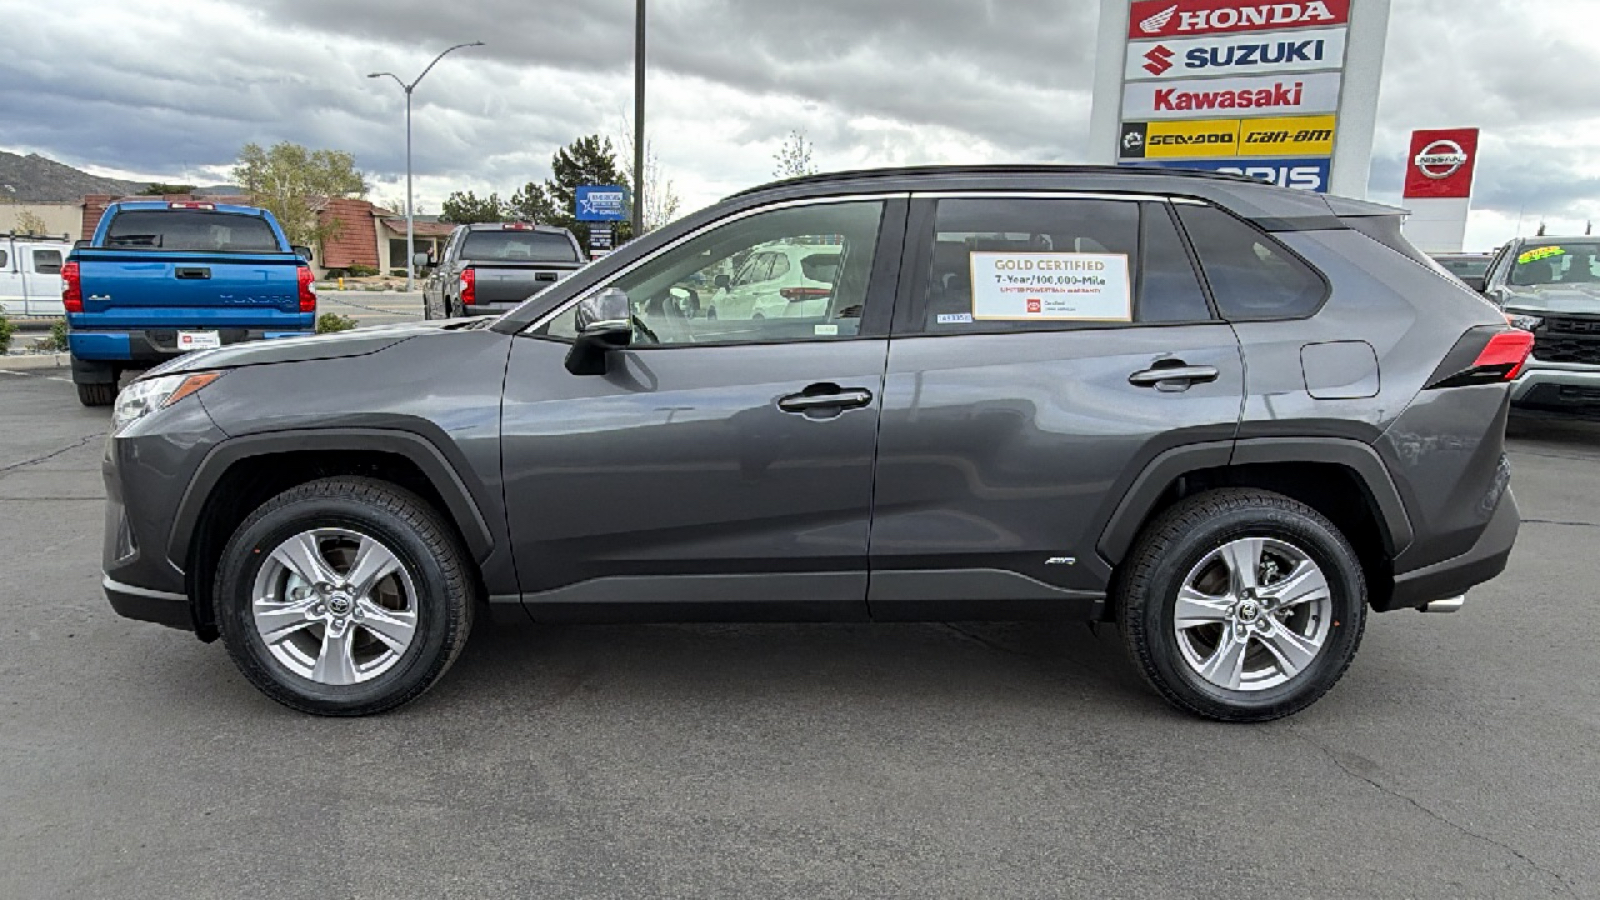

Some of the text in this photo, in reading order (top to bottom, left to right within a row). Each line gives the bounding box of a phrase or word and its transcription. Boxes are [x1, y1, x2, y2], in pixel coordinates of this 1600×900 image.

[1177, 1, 1335, 31] HONDA
[1185, 40, 1324, 68] SUZUKI
[1154, 82, 1303, 110] Kawasaki
[1420, 155, 1461, 163] NISSAN
[995, 259, 1105, 271] GOLD CERTIFIED
